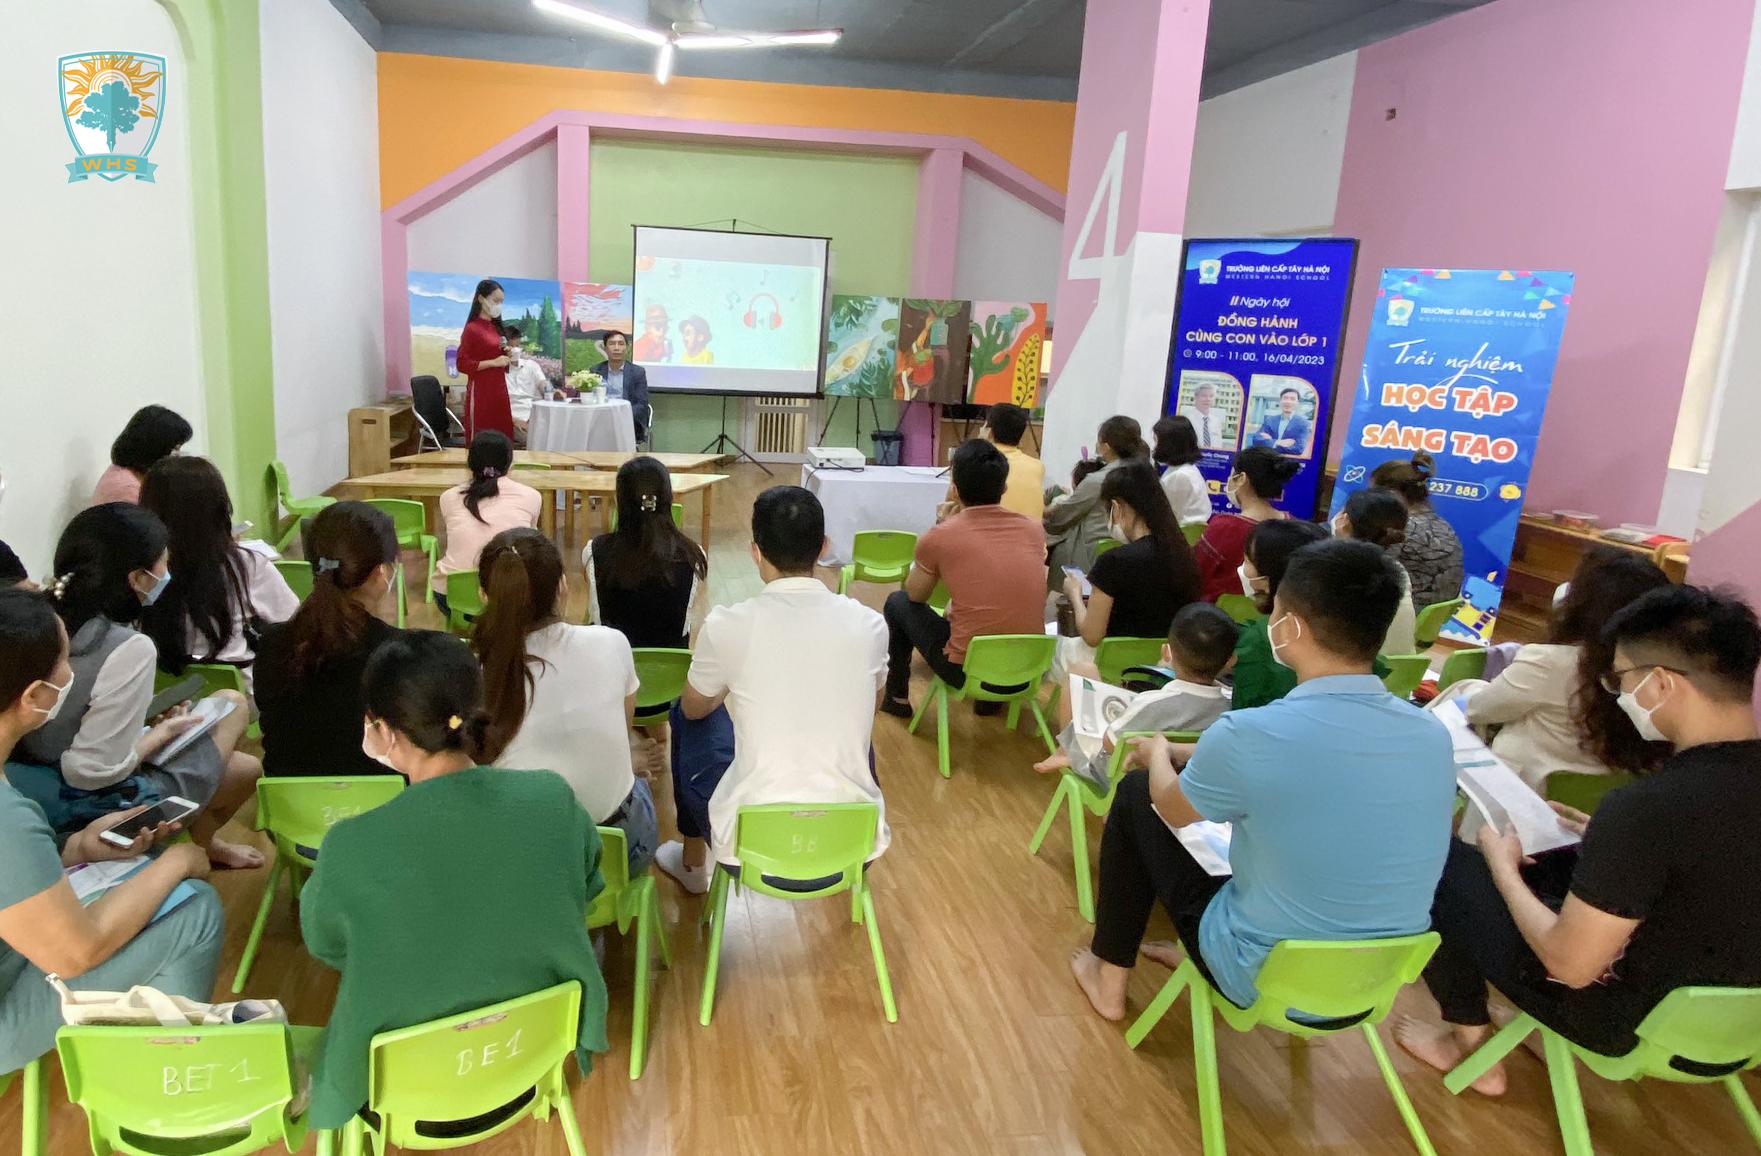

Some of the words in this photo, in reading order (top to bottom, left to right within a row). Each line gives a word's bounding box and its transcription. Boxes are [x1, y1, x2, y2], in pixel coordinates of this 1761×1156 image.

[1255, 264, 1271, 273] LIÊN
[1271, 263, 1288, 273] CẤP
[1288, 264, 1302, 273] TÂY
[1315, 264, 1331, 275] NỘI
[1240, 296, 1271, 309] Ngày
[1272, 297, 1291, 309] hội
[1217, 312, 1258, 328] ĐỒNG
[1528, 310, 1547, 321] NỘI
[1185, 328, 1223, 343] CÙNG
[1225, 333, 1256, 345] CON
[1291, 333, 1318, 347] LỚP
[1321, 336, 1327, 348] 1
[1195, 349, 1217, 360] 9:00
[1263, 352, 1325, 365] 16/04/2023
[1388, 338, 1437, 365] Trải
[1437, 342, 1523, 386] nghiệm
[1381, 383, 1447, 412] HỌC
[1454, 386, 1518, 418] TẬP
[1361, 420, 1446, 453] SÁNG
[1451, 432, 1518, 463] TẠO
[1428, 481, 1452, 493] 237
[1455, 485, 1479, 497] 888
